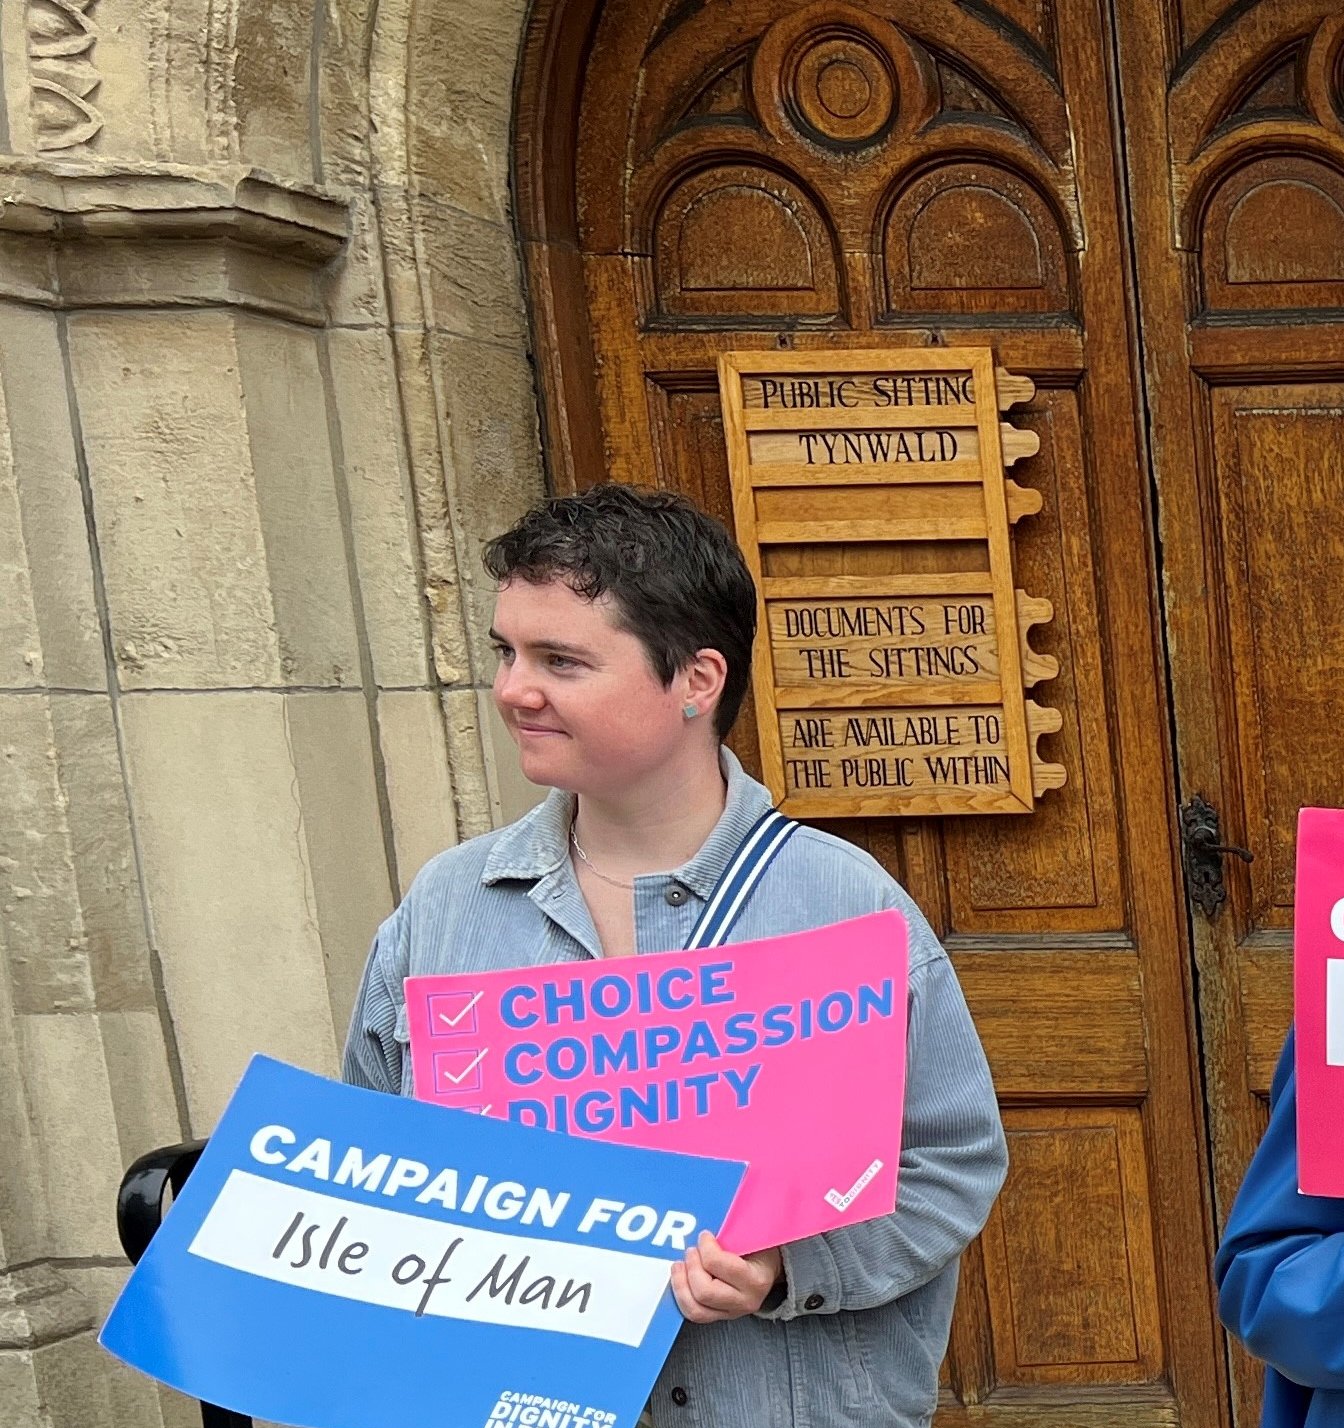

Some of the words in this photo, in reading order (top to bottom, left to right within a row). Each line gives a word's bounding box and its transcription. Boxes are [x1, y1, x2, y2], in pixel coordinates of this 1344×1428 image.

[761, 379, 860, 409] PUBLIC
[799, 431, 958, 465] TYNWALD
[785, 607, 926, 638] DOCUMENTS
[943, 604, 986, 635] FOR
[800, 648, 852, 679] THE
[869, 646, 980, 678] SITTINGS
[791, 718, 834, 748] ARE
[843, 716, 961, 746] AVAILABLE
[967, 714, 1001, 745] TO
[787, 758, 832, 788] THE
[842, 757, 915, 787] PUBLIC
[924, 755, 1011, 786] WITHIN
[499, 961, 736, 1030] CHOICE
[503, 978, 893, 1086] COMPASSION
[507, 1064, 761, 1135] DIGNITY
[249, 1124, 571, 1228] CAMPAIGN
[577, 1197, 698, 1251] FOR
[271, 1210, 370, 1276] Isle
[390, 1236, 465, 1318] of
[464, 1253, 593, 1315] Man
[500, 1391, 580, 1415] CAMPAIGN
[582, 1406, 617, 1425] FOR
